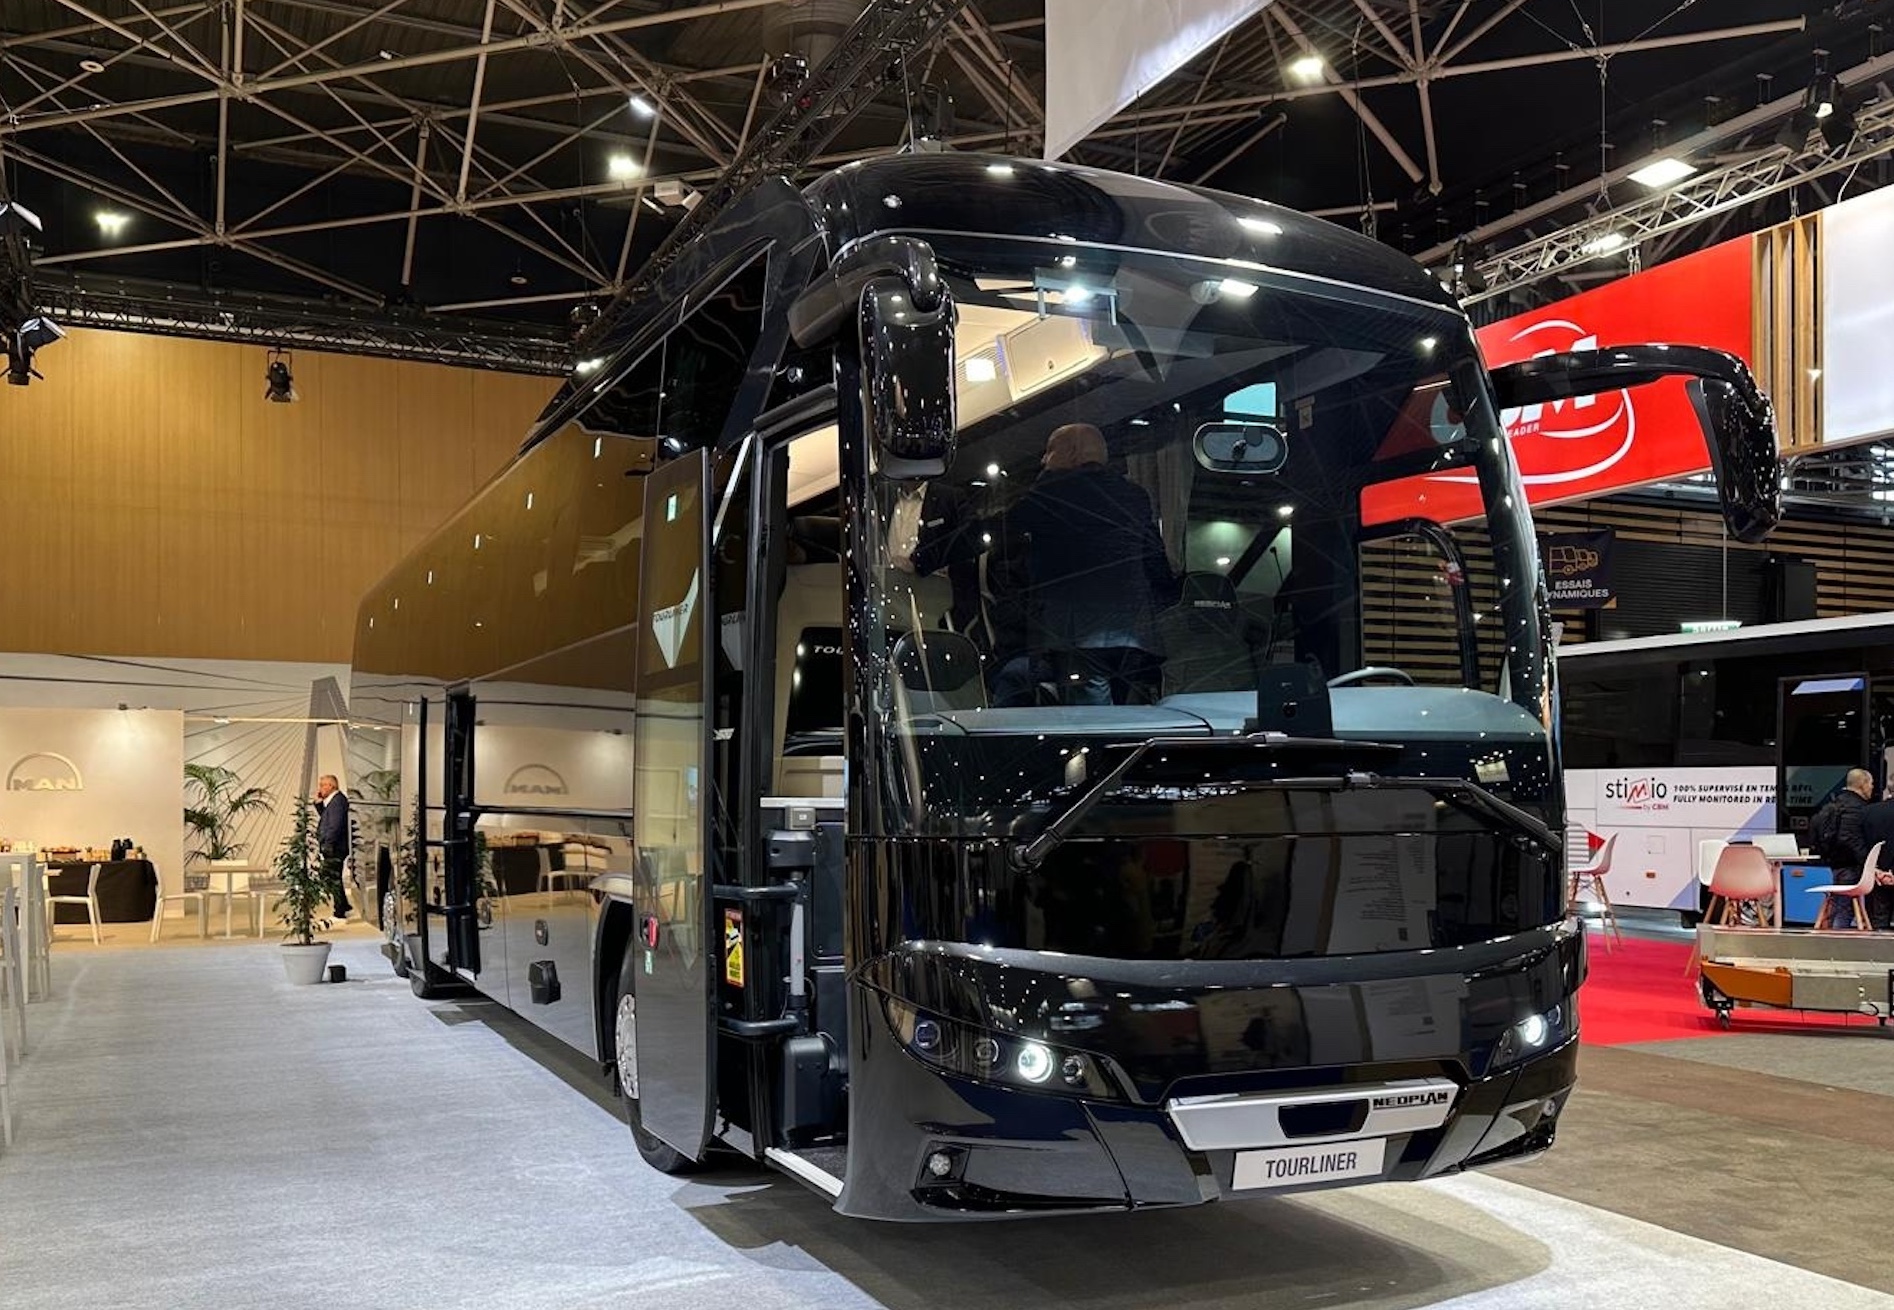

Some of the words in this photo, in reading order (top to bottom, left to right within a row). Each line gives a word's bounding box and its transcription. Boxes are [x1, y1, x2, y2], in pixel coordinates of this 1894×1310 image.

[1507, 422, 1540, 438] EADER
[1554, 579, 1593, 589] ESSAIS
[1547, 588, 1610, 599] YNAMIQUES
[13, 778, 77, 791] MAN
[1673, 784, 1696, 793] 100%
[1698, 783, 1744, 793] SUPERVISÉ
[1746, 784, 1757, 792] EN
[1673, 795, 1697, 803] FULLY
[1699, 795, 1751, 803] MONITORED
[1373, 1092, 1448, 1108] NEOPLAN
[1265, 1151, 1357, 1179] TOURLINER
